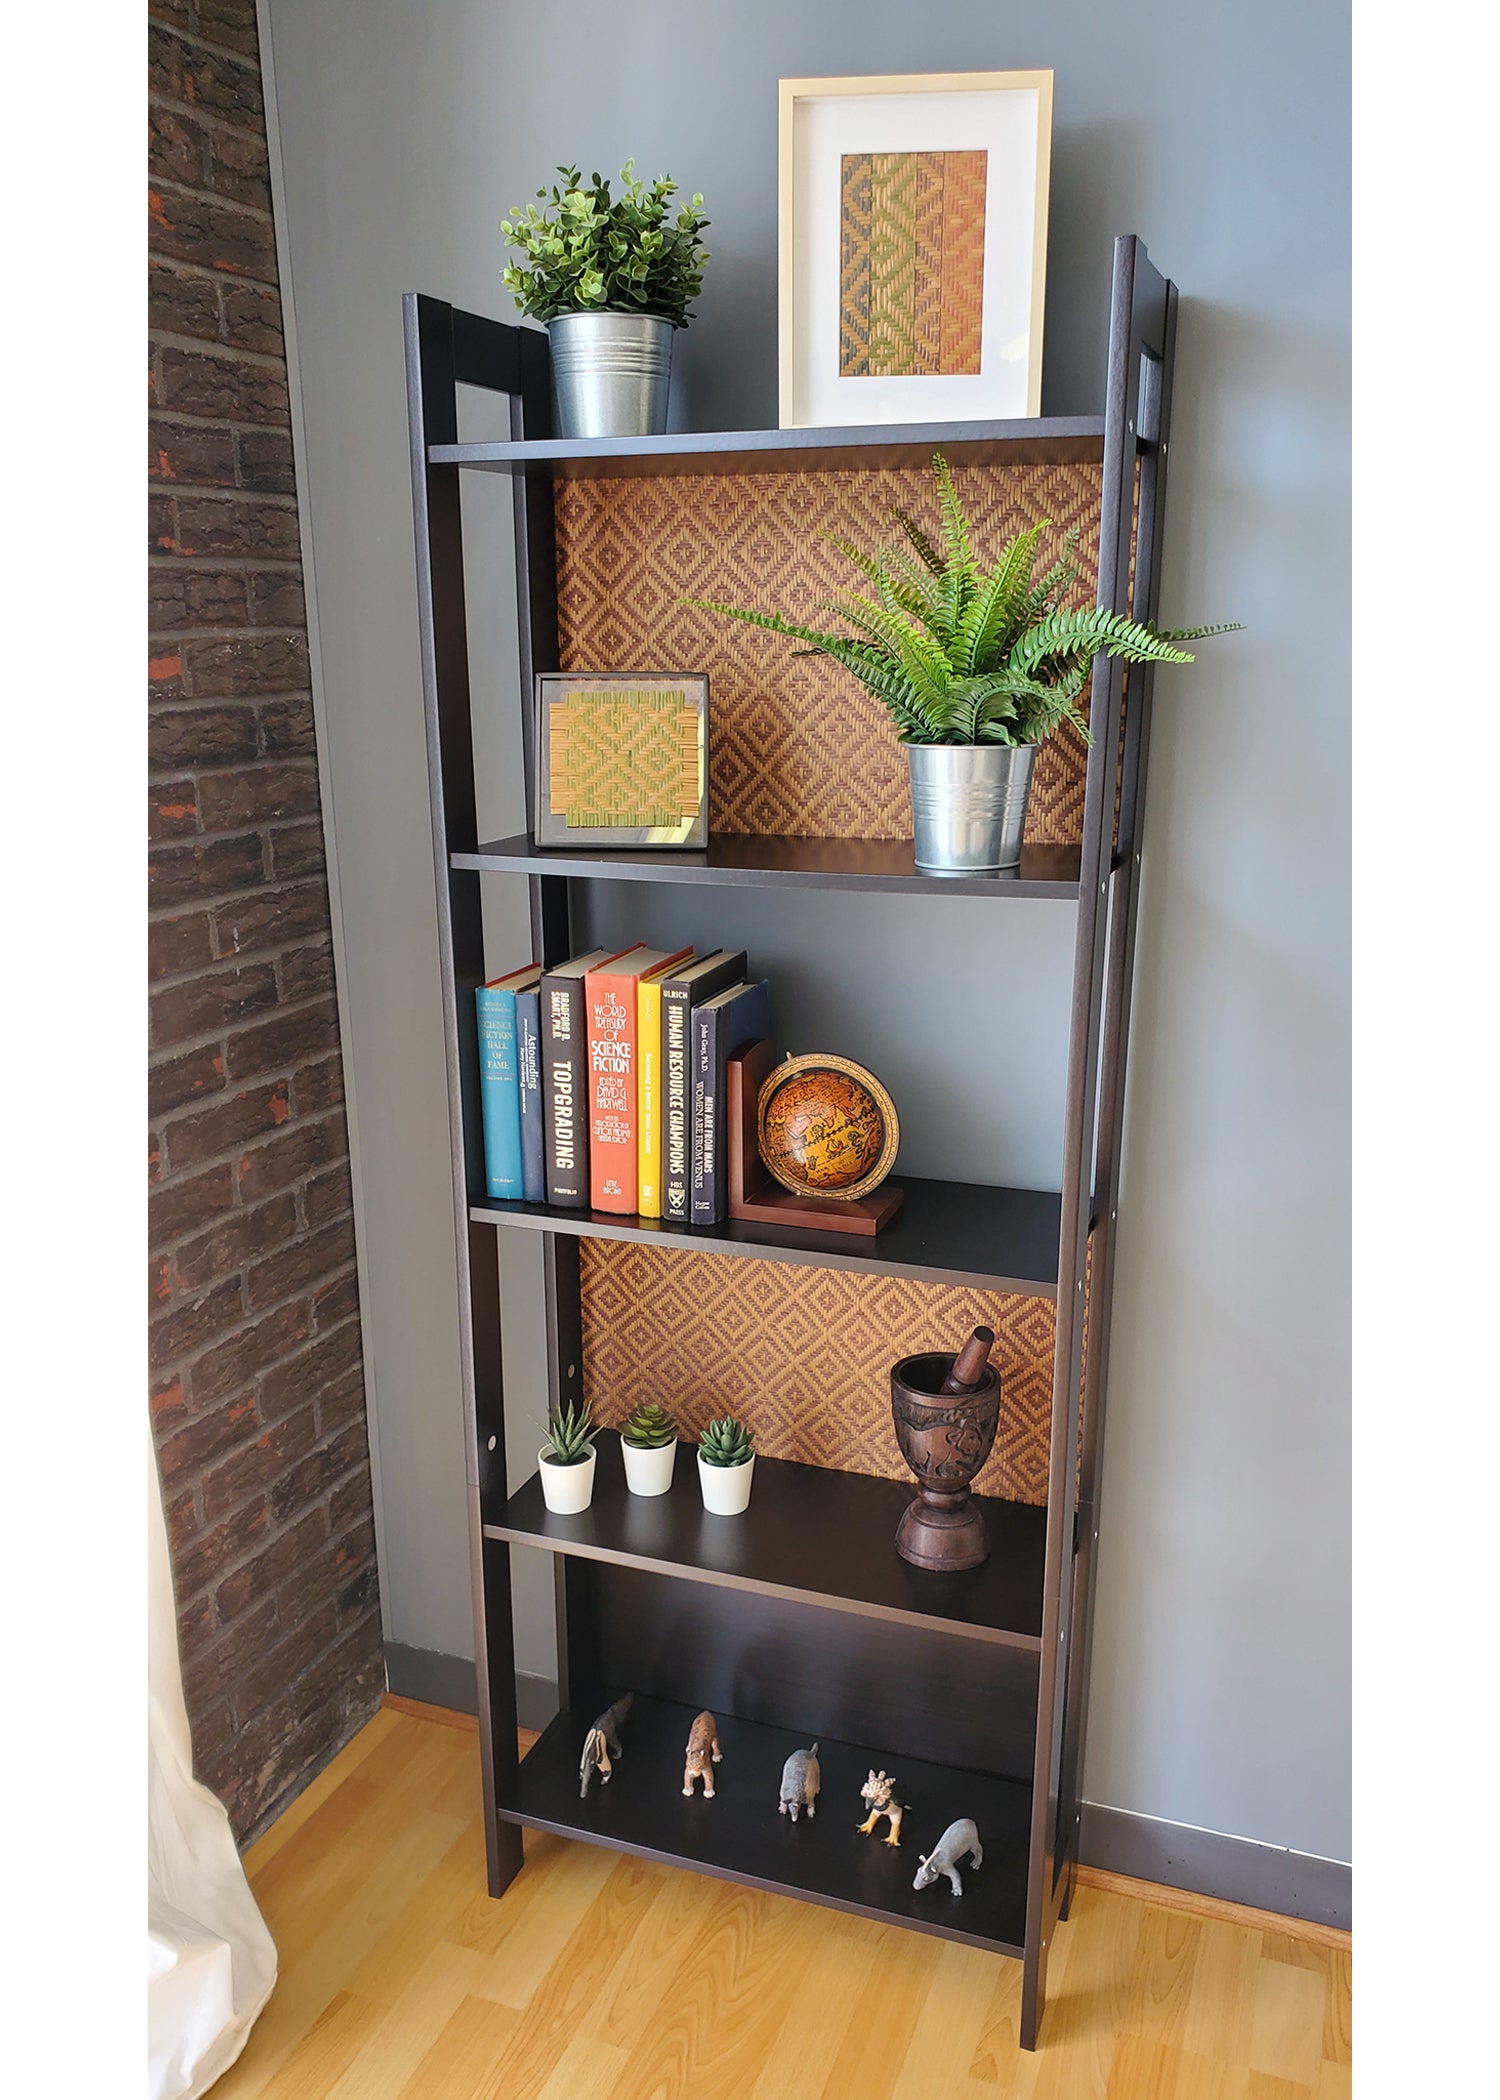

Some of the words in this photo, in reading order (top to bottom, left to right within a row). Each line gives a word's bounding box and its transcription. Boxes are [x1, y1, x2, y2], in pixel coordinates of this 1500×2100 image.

[604, 992, 616, 1005] THE
[663, 990, 688, 999] ULRICH
[560, 992, 571, 1032] BRADFORD
[594, 1004, 627, 1018] WORLD
[482, 1021, 512, 1029] SCIENCE
[668, 1005, 684, 1049] HUMAN
[700, 1024, 708, 1039] John
[482, 1031, 513, 1039] FICTION
[603, 1029, 618, 1041] OF
[487, 1041, 508, 1050] HALL
[591, 1040, 631, 1058] SCIENCE
[487, 1061, 510, 1070] FAME
[527, 1034, 539, 1090] Astounding
[593, 1057, 630, 1074] FICTION
[669, 1051, 684, 1109] RESOURCE
[596, 1085, 619, 1098] DAVID
[695, 1081, 704, 1116] WOMEN
[596, 1097, 628, 1111] HARTWELL
[704, 1096, 713, 1113] MEN
[552, 1061, 574, 1169] TOPGRADING
[704, 1113, 713, 1129] ARE
[695, 1117, 703, 1134] ARE
[669, 1110, 684, 1174] CHAMPIONS
[695, 1135, 703, 1160] FROM
[704, 1130, 713, 1151] FROM
[703, 1152, 713, 1174] MARS
[694, 1160, 703, 1189] VENUS
[554, 1187, 577, 1195] PORTFOLIO
[669, 1208, 685, 1216] PRESS
